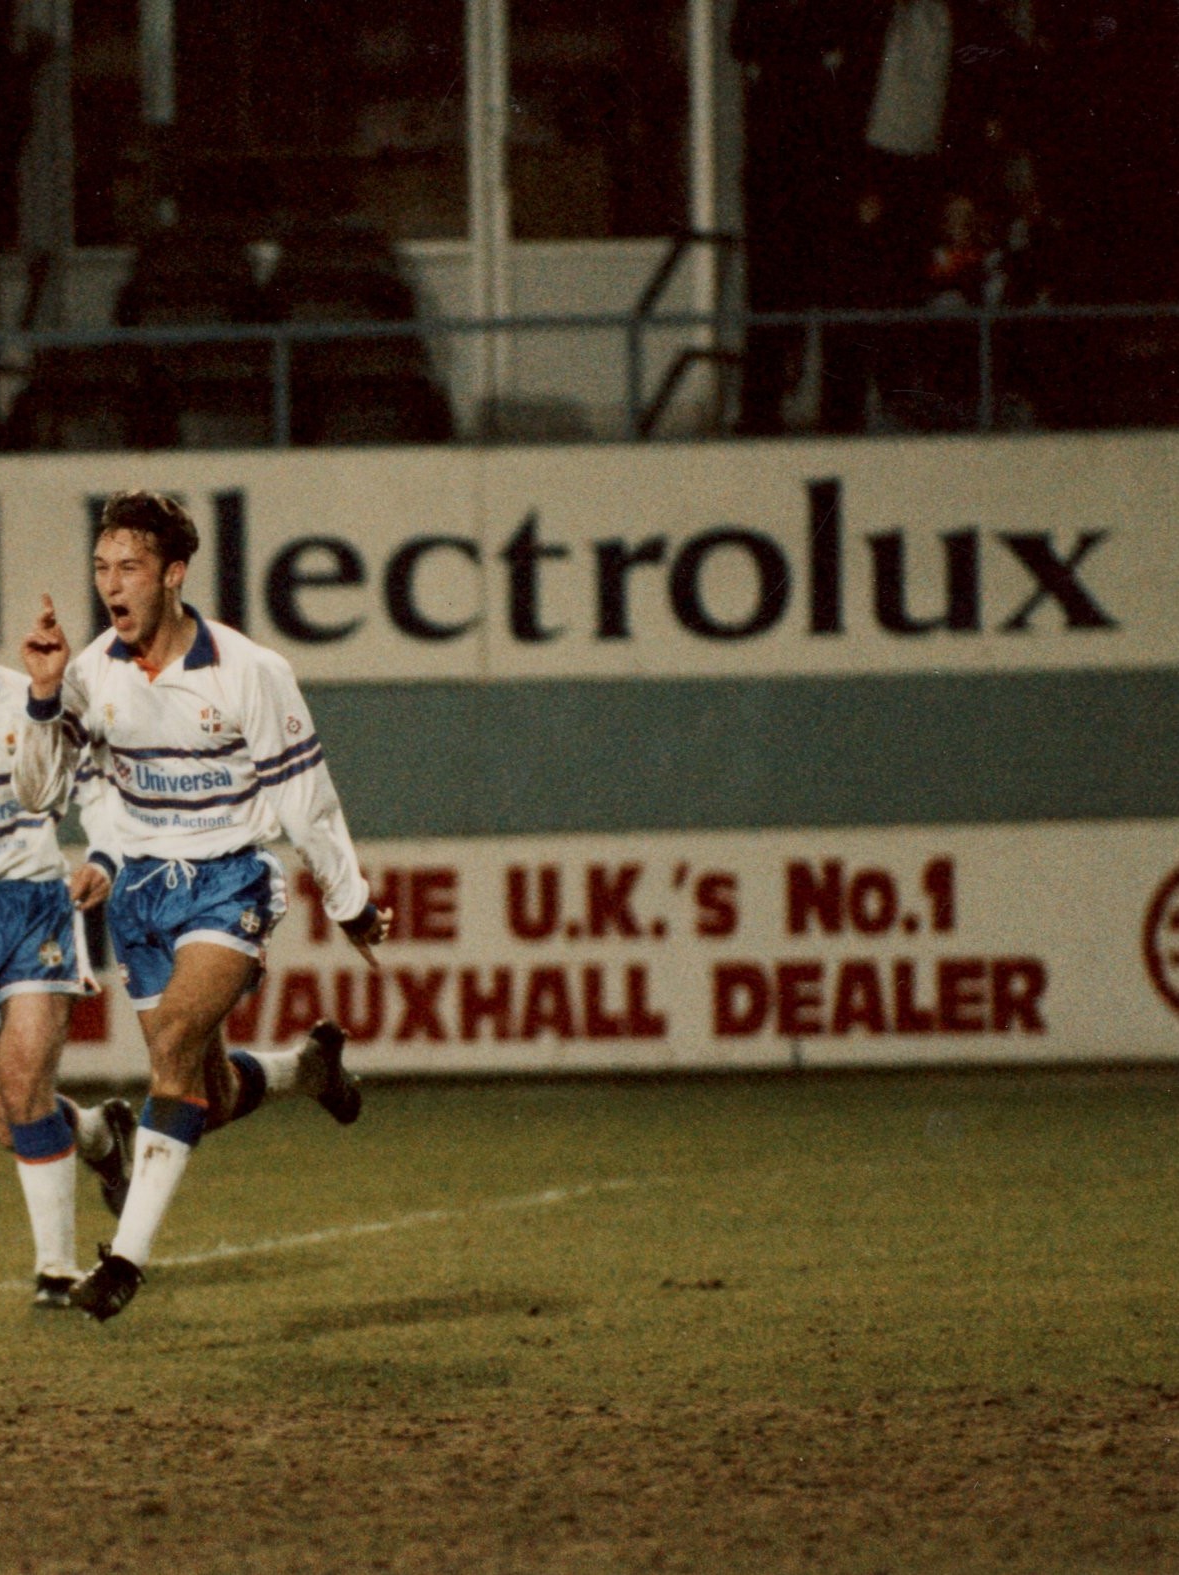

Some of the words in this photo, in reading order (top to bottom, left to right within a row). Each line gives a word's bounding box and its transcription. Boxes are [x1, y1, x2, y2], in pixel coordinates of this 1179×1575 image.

[84, 474, 1121, 646] lectrolux
[135, 764, 233, 793] Universal
[172, 813, 233, 829] Auctions
[786, 860, 951, 934] No.1
[711, 958, 1043, 1039] DEALER
